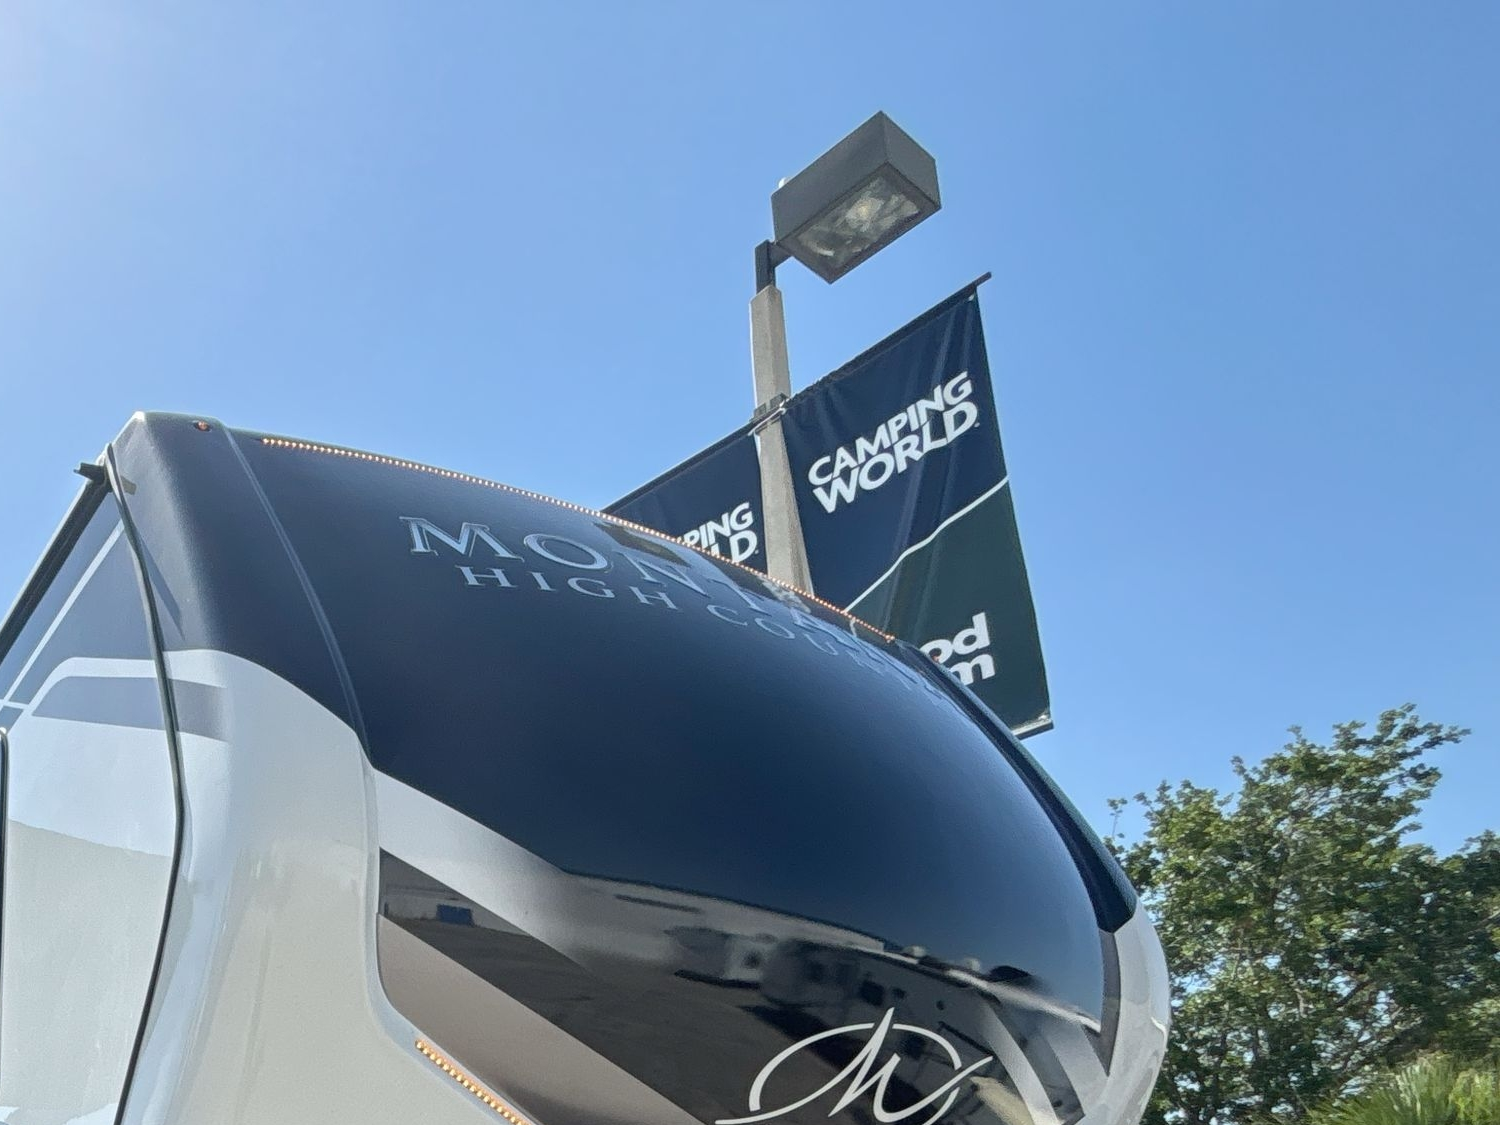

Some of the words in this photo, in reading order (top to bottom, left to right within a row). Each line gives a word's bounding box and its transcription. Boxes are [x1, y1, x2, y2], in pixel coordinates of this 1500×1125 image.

[807, 370, 974, 487] CAMPING
[812, 401, 979, 514] WORLD
[677, 501, 754, 549] PING
[455, 565, 678, 610] HIGH
[919, 611, 991, 664] od
